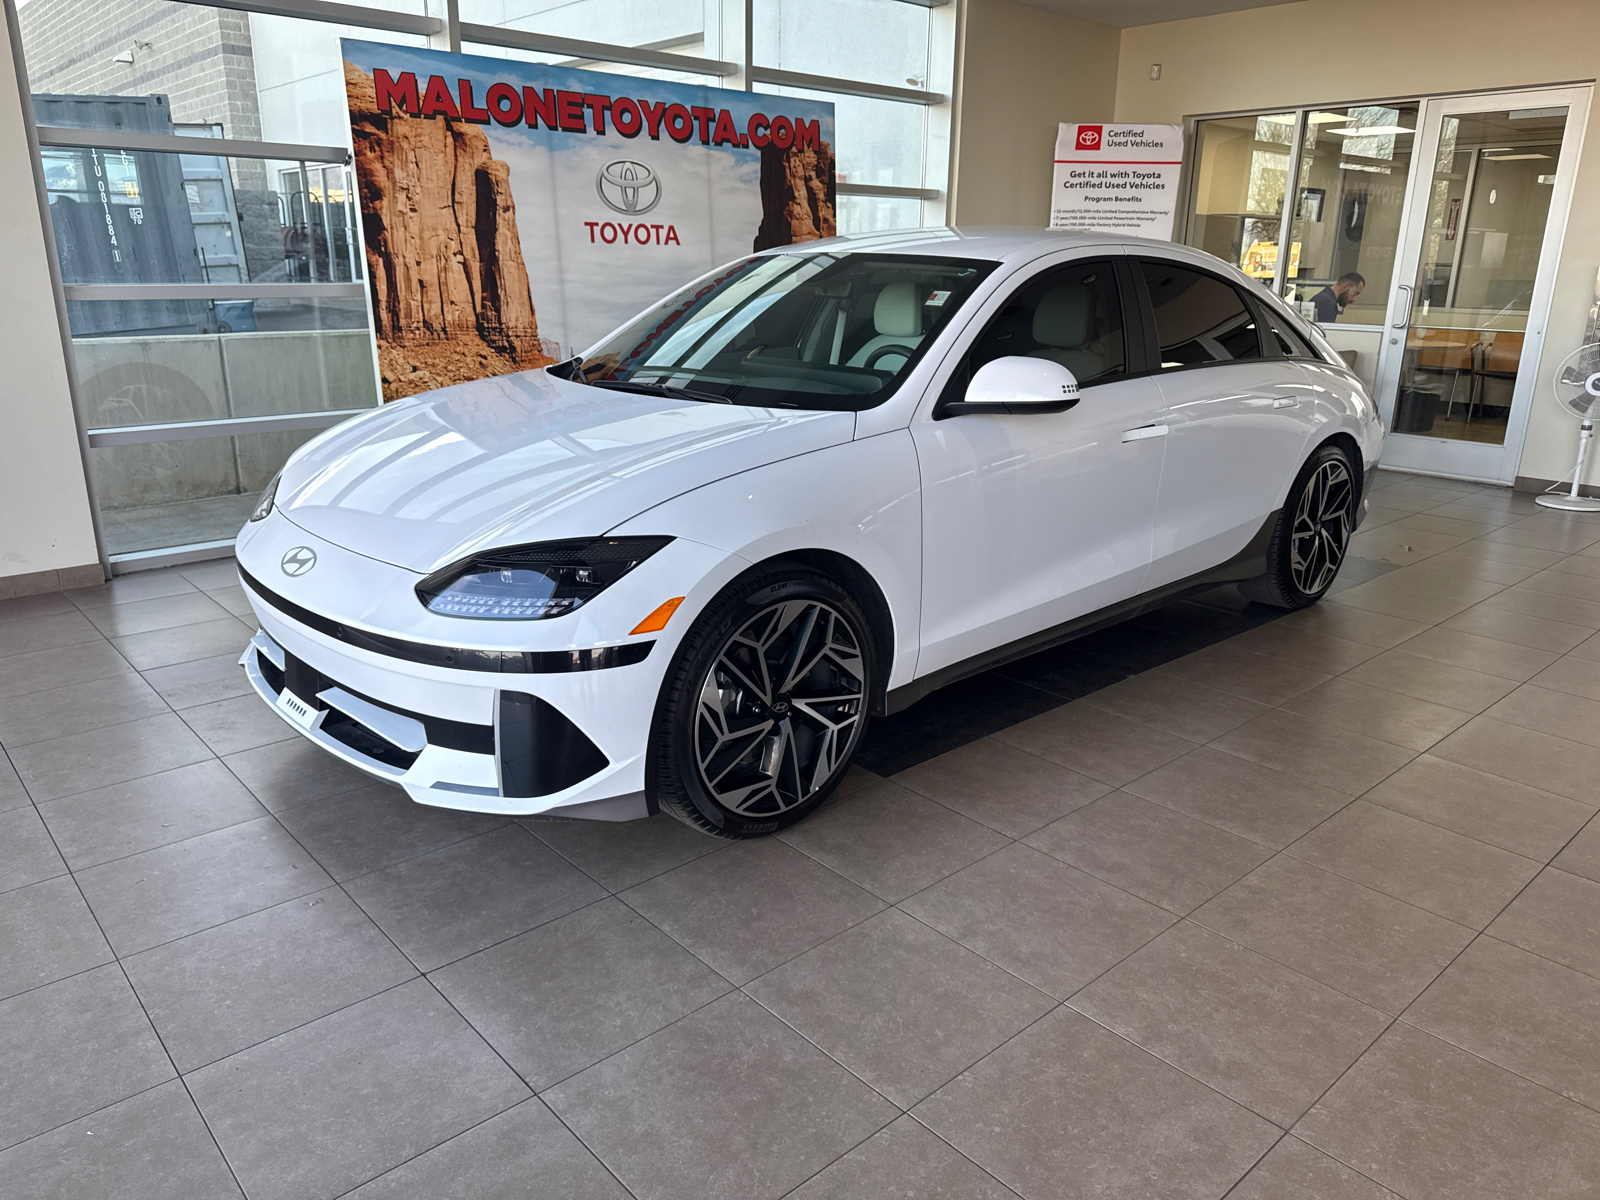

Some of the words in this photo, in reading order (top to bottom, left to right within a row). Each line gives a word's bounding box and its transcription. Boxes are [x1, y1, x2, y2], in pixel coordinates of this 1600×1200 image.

[373, 68, 820, 153] MALONETOYOTA.COM
[1108, 129, 1144, 138] Certified
[1107, 139, 1128, 147] Used
[1130, 139, 1164, 148] Vehicles
[1070, 170, 1086, 178] Get
[1088, 170, 1094, 178] it
[1096, 170, 1108, 178] all
[1110, 170, 1130, 179] with
[1132, 171, 1161, 180] Toyota
[1063, 180, 1102, 189] Certified
[1105, 181, 1127, 189] Used
[1129, 181, 1165, 190] Vehicles
[1084, 195, 1113, 203] Program
[1114, 195, 1142, 203] Benefits
[584, 221, 681, 246] TOYOTA
